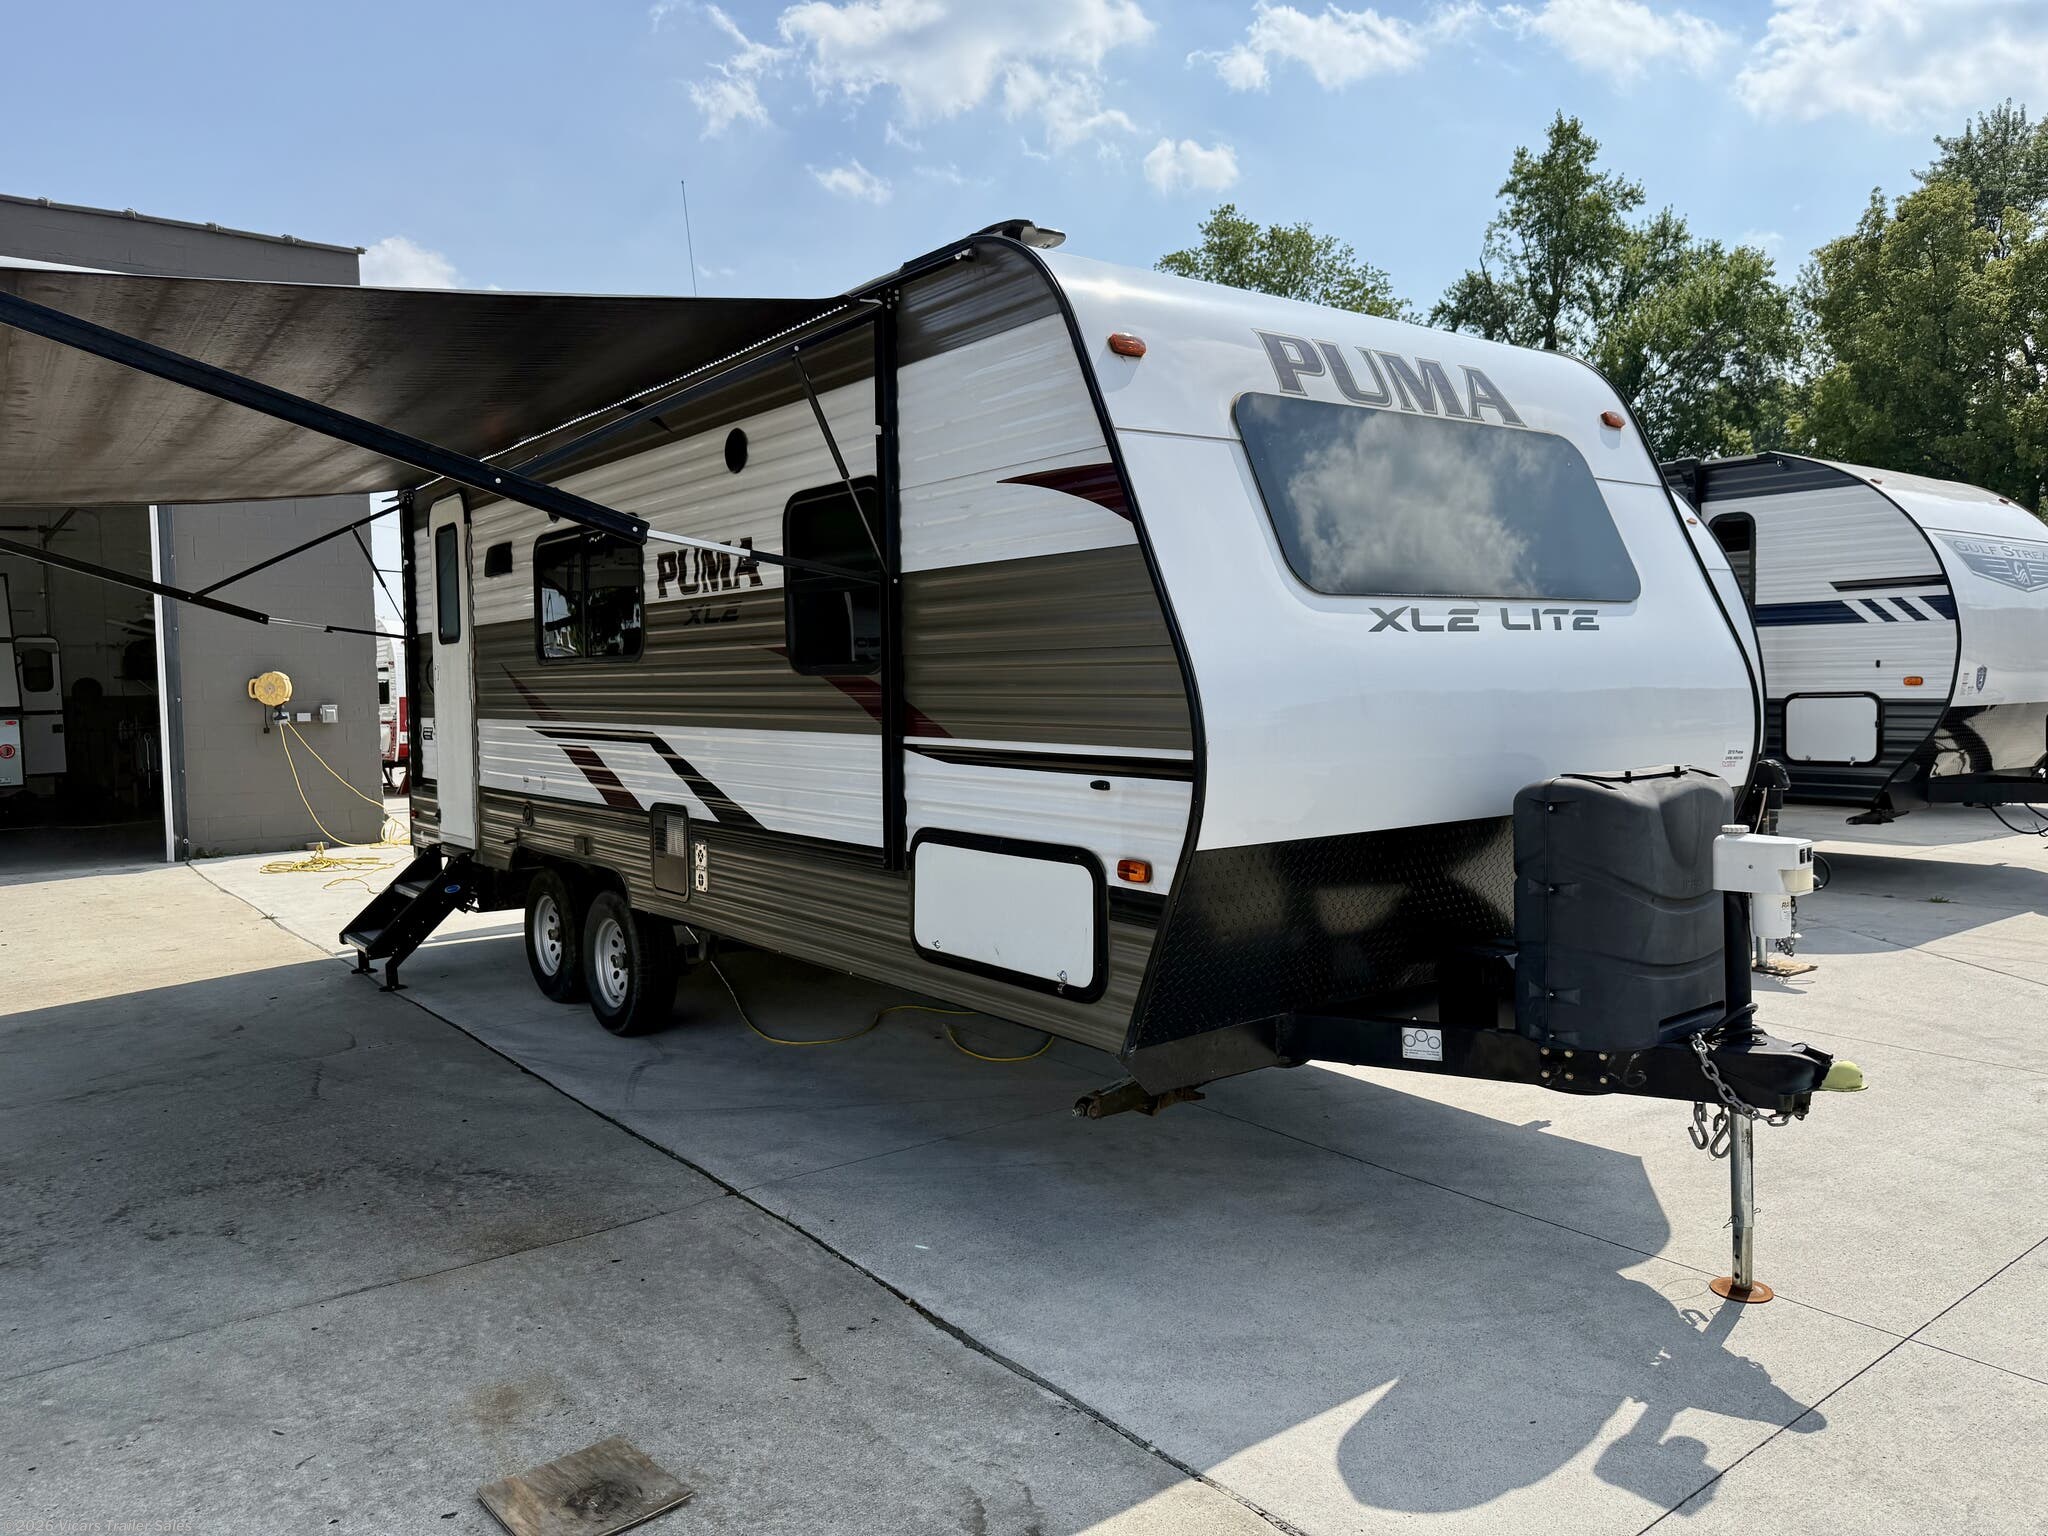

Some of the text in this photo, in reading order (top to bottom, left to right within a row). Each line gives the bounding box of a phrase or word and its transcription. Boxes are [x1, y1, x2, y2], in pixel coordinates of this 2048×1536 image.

[1250, 327, 1528, 428] PUMA
[657, 537, 763, 598] PUMA
[683, 601, 743, 626] XLE
[1368, 605, 1600, 632] XLE LITE
